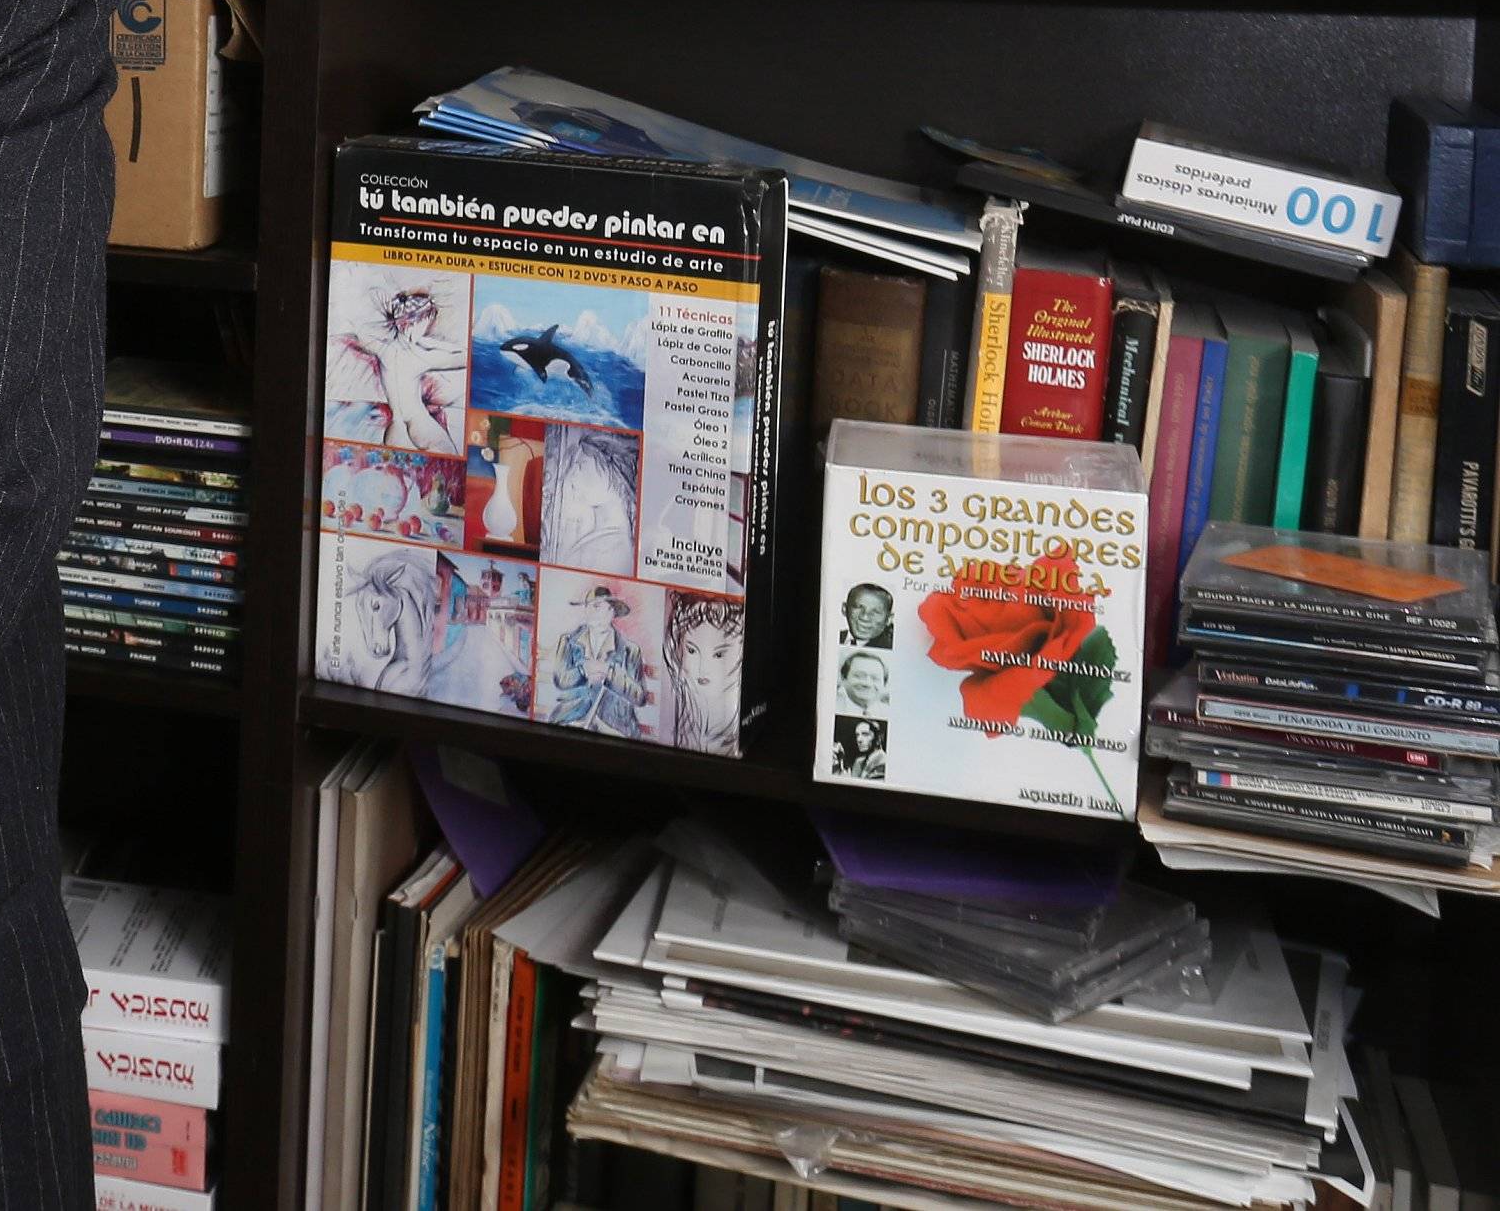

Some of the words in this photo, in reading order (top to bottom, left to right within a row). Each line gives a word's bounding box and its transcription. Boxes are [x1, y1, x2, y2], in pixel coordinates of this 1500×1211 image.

[360, 173, 428, 189] COLECCIÓN
[1136, 172, 1193, 195] clásicas
[1175, 163, 1251, 188] preferidas
[1197, 188, 1277, 216] Miniaturas
[359, 187, 384, 210] tú
[392, 189, 496, 221] también
[503, 205, 598, 231] puedes
[604, 210, 686, 238] pintar
[692, 224, 725, 245] en
[1117, 213, 1142, 227] PIAF
[1286, 187, 1384, 243] 100
[1144, 222, 1174, 236] EDITH
[360, 223, 448, 243] Transforma
[453, 232, 467, 245] tu
[472, 236, 538, 253] espacio
[544, 243, 564, 255] en
[569, 246, 588, 258] un
[594, 248, 657, 265] estudio
[662, 254, 683, 268] de
[689, 258, 723, 273] arte
[383, 250, 412, 261] LIBRO
[416, 253, 443, 265] TAPA
[446, 258, 475, 269] DURA
[488, 261, 534, 275] ESTUCHE
[538, 266, 564, 278] CON
[569, 270, 581, 280] 12
[584, 271, 617, 285] DVD'S
[621, 276, 651, 287] PASO
[655, 280, 663, 289] A
[667, 281, 698, 293] PASO
[660, 306, 671, 317] 11
[677, 309, 733, 325] Técnicas
[1054, 298, 1076, 313] The
[1034, 309, 1092, 329] Original
[652, 321, 678, 335] Lápiz
[681, 324, 694, 335] de
[697, 327, 733, 340] Grafito
[1026, 323, 1095, 345] Illustrated
[658, 337, 684, 351] Lápiz
[687, 340, 700, 352] de
[704, 343, 732, 355] Color
[980, 300, 1007, 385] Sherlock
[670, 355, 731, 372] Carboncillo
[1023, 341, 1096, 369] SHERLOCK
[682, 372, 730, 387] Acuarela
[1028, 364, 1086, 389] HOLMES
[1115, 335, 1140, 427] Mechanical
[678, 387, 707, 400] Pastel
[711, 391, 730, 403] Tiza
[664, 401, 694, 414] Pastel
[698, 405, 729, 418] Graso
[694, 419, 720, 433] Óleo
[694, 435, 718, 448] Óleo
[721, 441, 728, 450] 2
[668, 463, 692, 477] Tinta
[696, 467, 726, 481] China
[681, 481, 726, 497] Espátula
[675, 495, 725, 511] Crayones
[929, 489, 948, 514] 3
[132, 522, 163, 533] AFRICAN
[671, 537, 723, 558] Incluye
[644, 556, 658, 567] De
[660, 559, 685, 572] cada
[687, 562, 723, 578] técnica
[656, 549, 683, 563] Paso
[686, 556, 693, 564] a
[696, 556, 723, 569] Paso
[902, 577, 928, 591] Por
[933, 582, 956, 597] sus
[960, 584, 1018, 604] grandes
